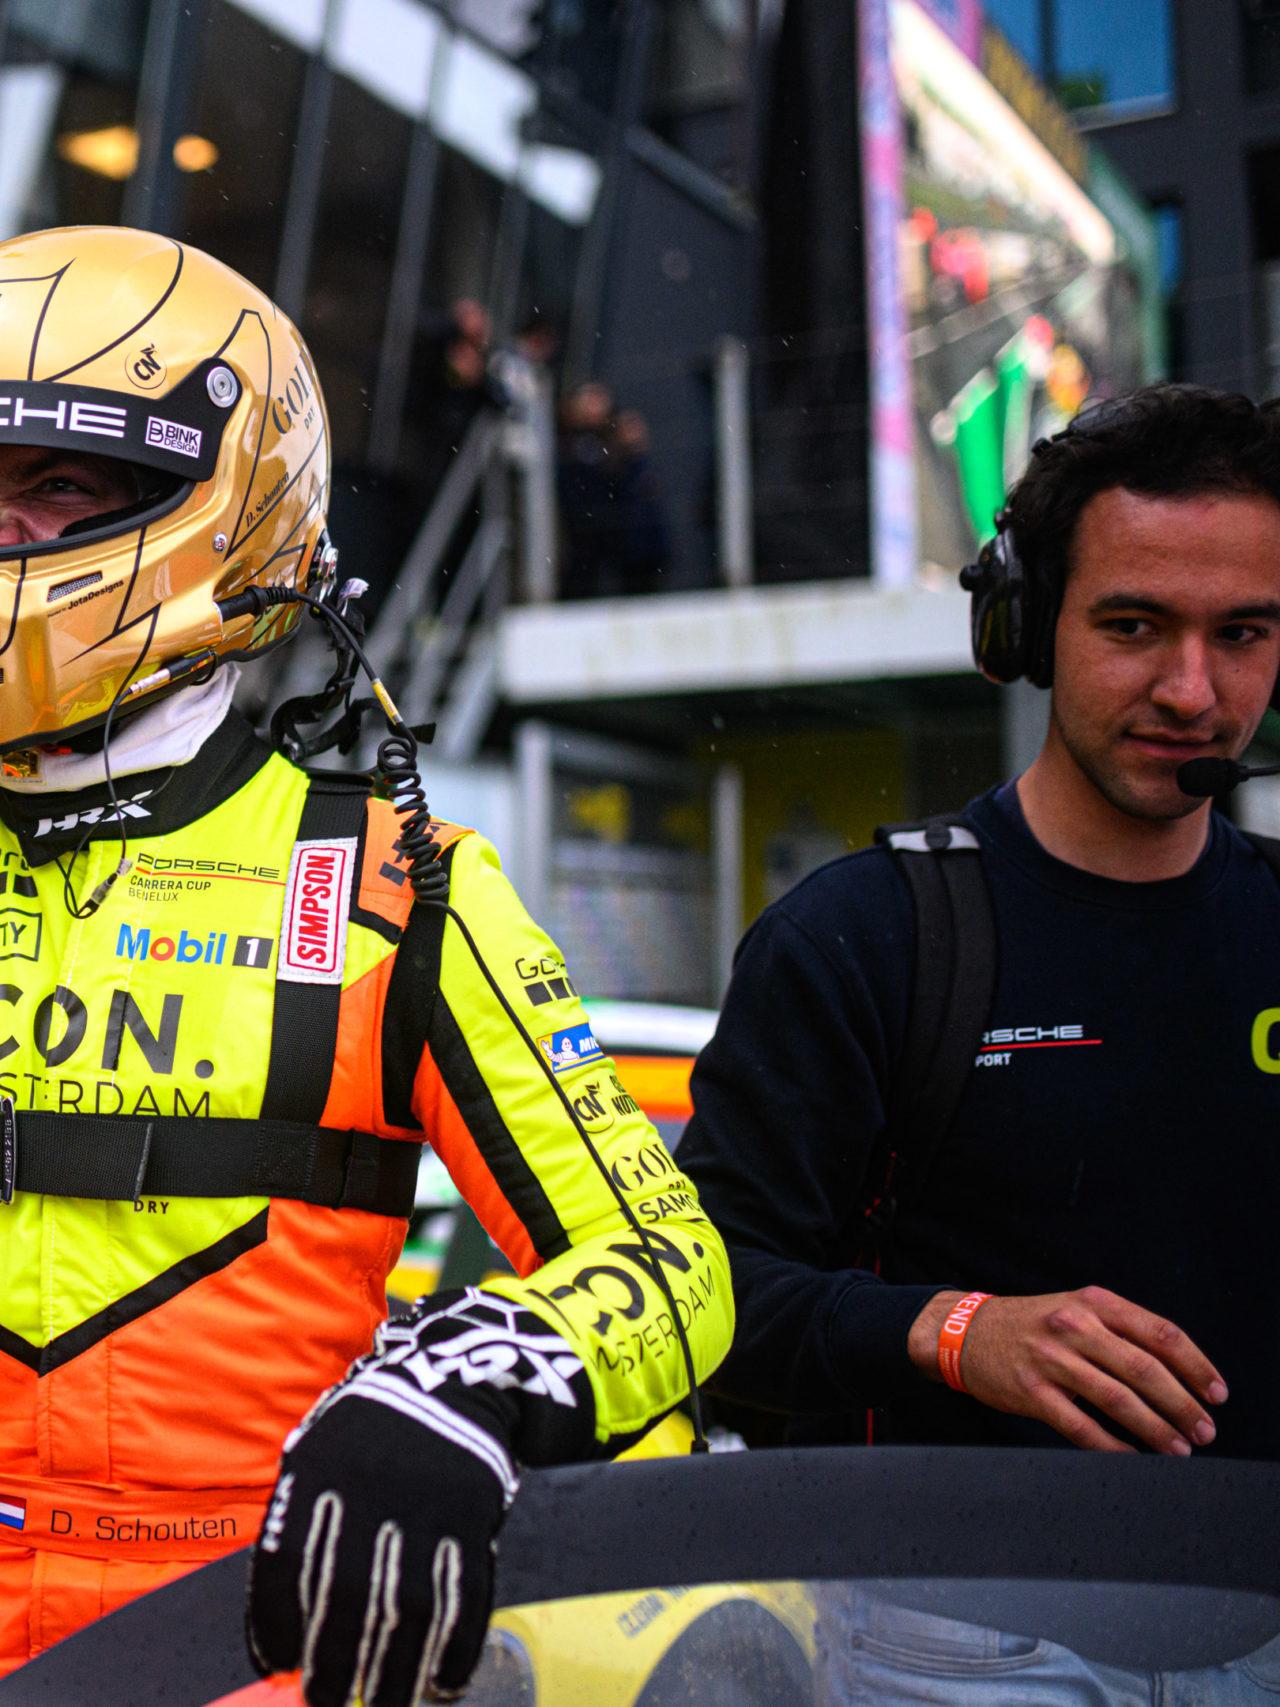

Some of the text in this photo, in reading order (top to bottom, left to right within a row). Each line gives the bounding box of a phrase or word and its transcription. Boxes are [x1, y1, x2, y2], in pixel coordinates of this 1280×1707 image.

[164, 437, 199, 455] DESIGN
[165, 424, 200, 446] BINK
[256, 471, 290, 515] Schouten
[67, 579, 125, 610] JotaDesigns
[34, 789, 153, 838] HRX
[137, 852, 280, 879] PORSCHE
[128, 887, 179, 902] BENELUX
[130, 875, 212, 891] CARRERA CUP
[297, 853, 336, 964] SIMPSON
[115, 923, 228, 965] Mobil
[133, 1200, 170, 1215] DRY
[50, 1509, 237, 1543] D. Schouten
